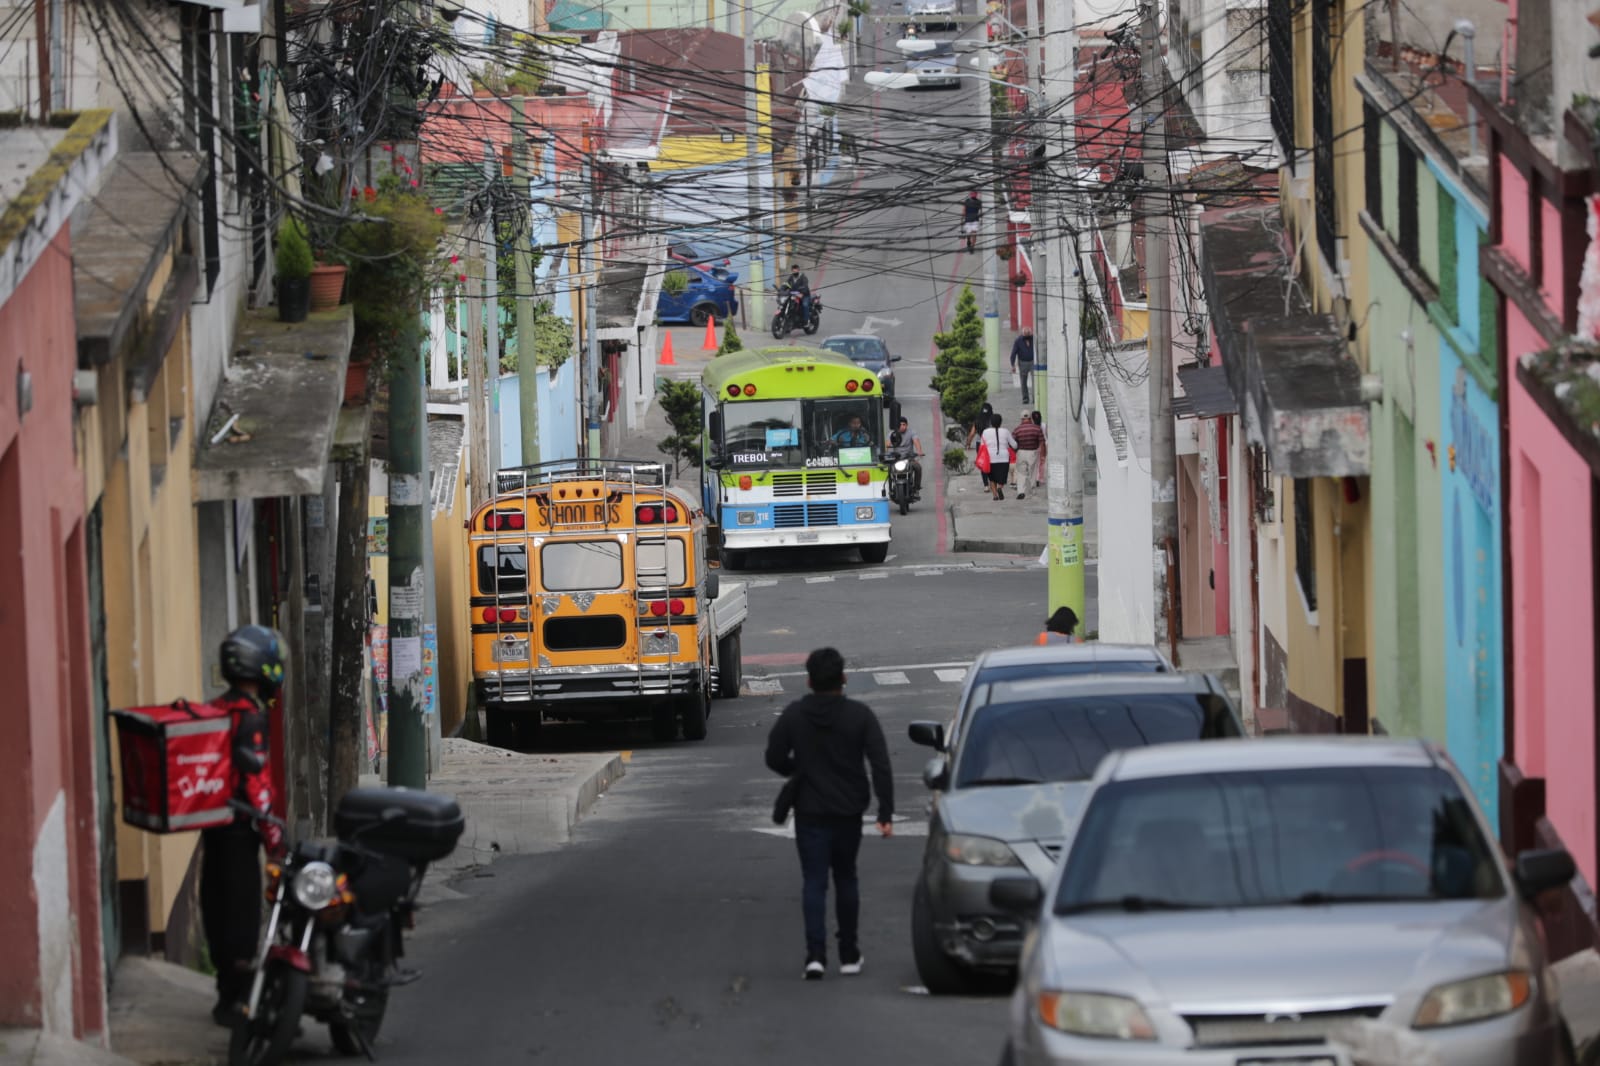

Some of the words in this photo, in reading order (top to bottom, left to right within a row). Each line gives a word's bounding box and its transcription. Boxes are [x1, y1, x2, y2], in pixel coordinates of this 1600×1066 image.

[732, 453, 769, 464] TREBOL
[538, 503, 587, 527] SCHOOL
[593, 503, 621, 524] BUS
